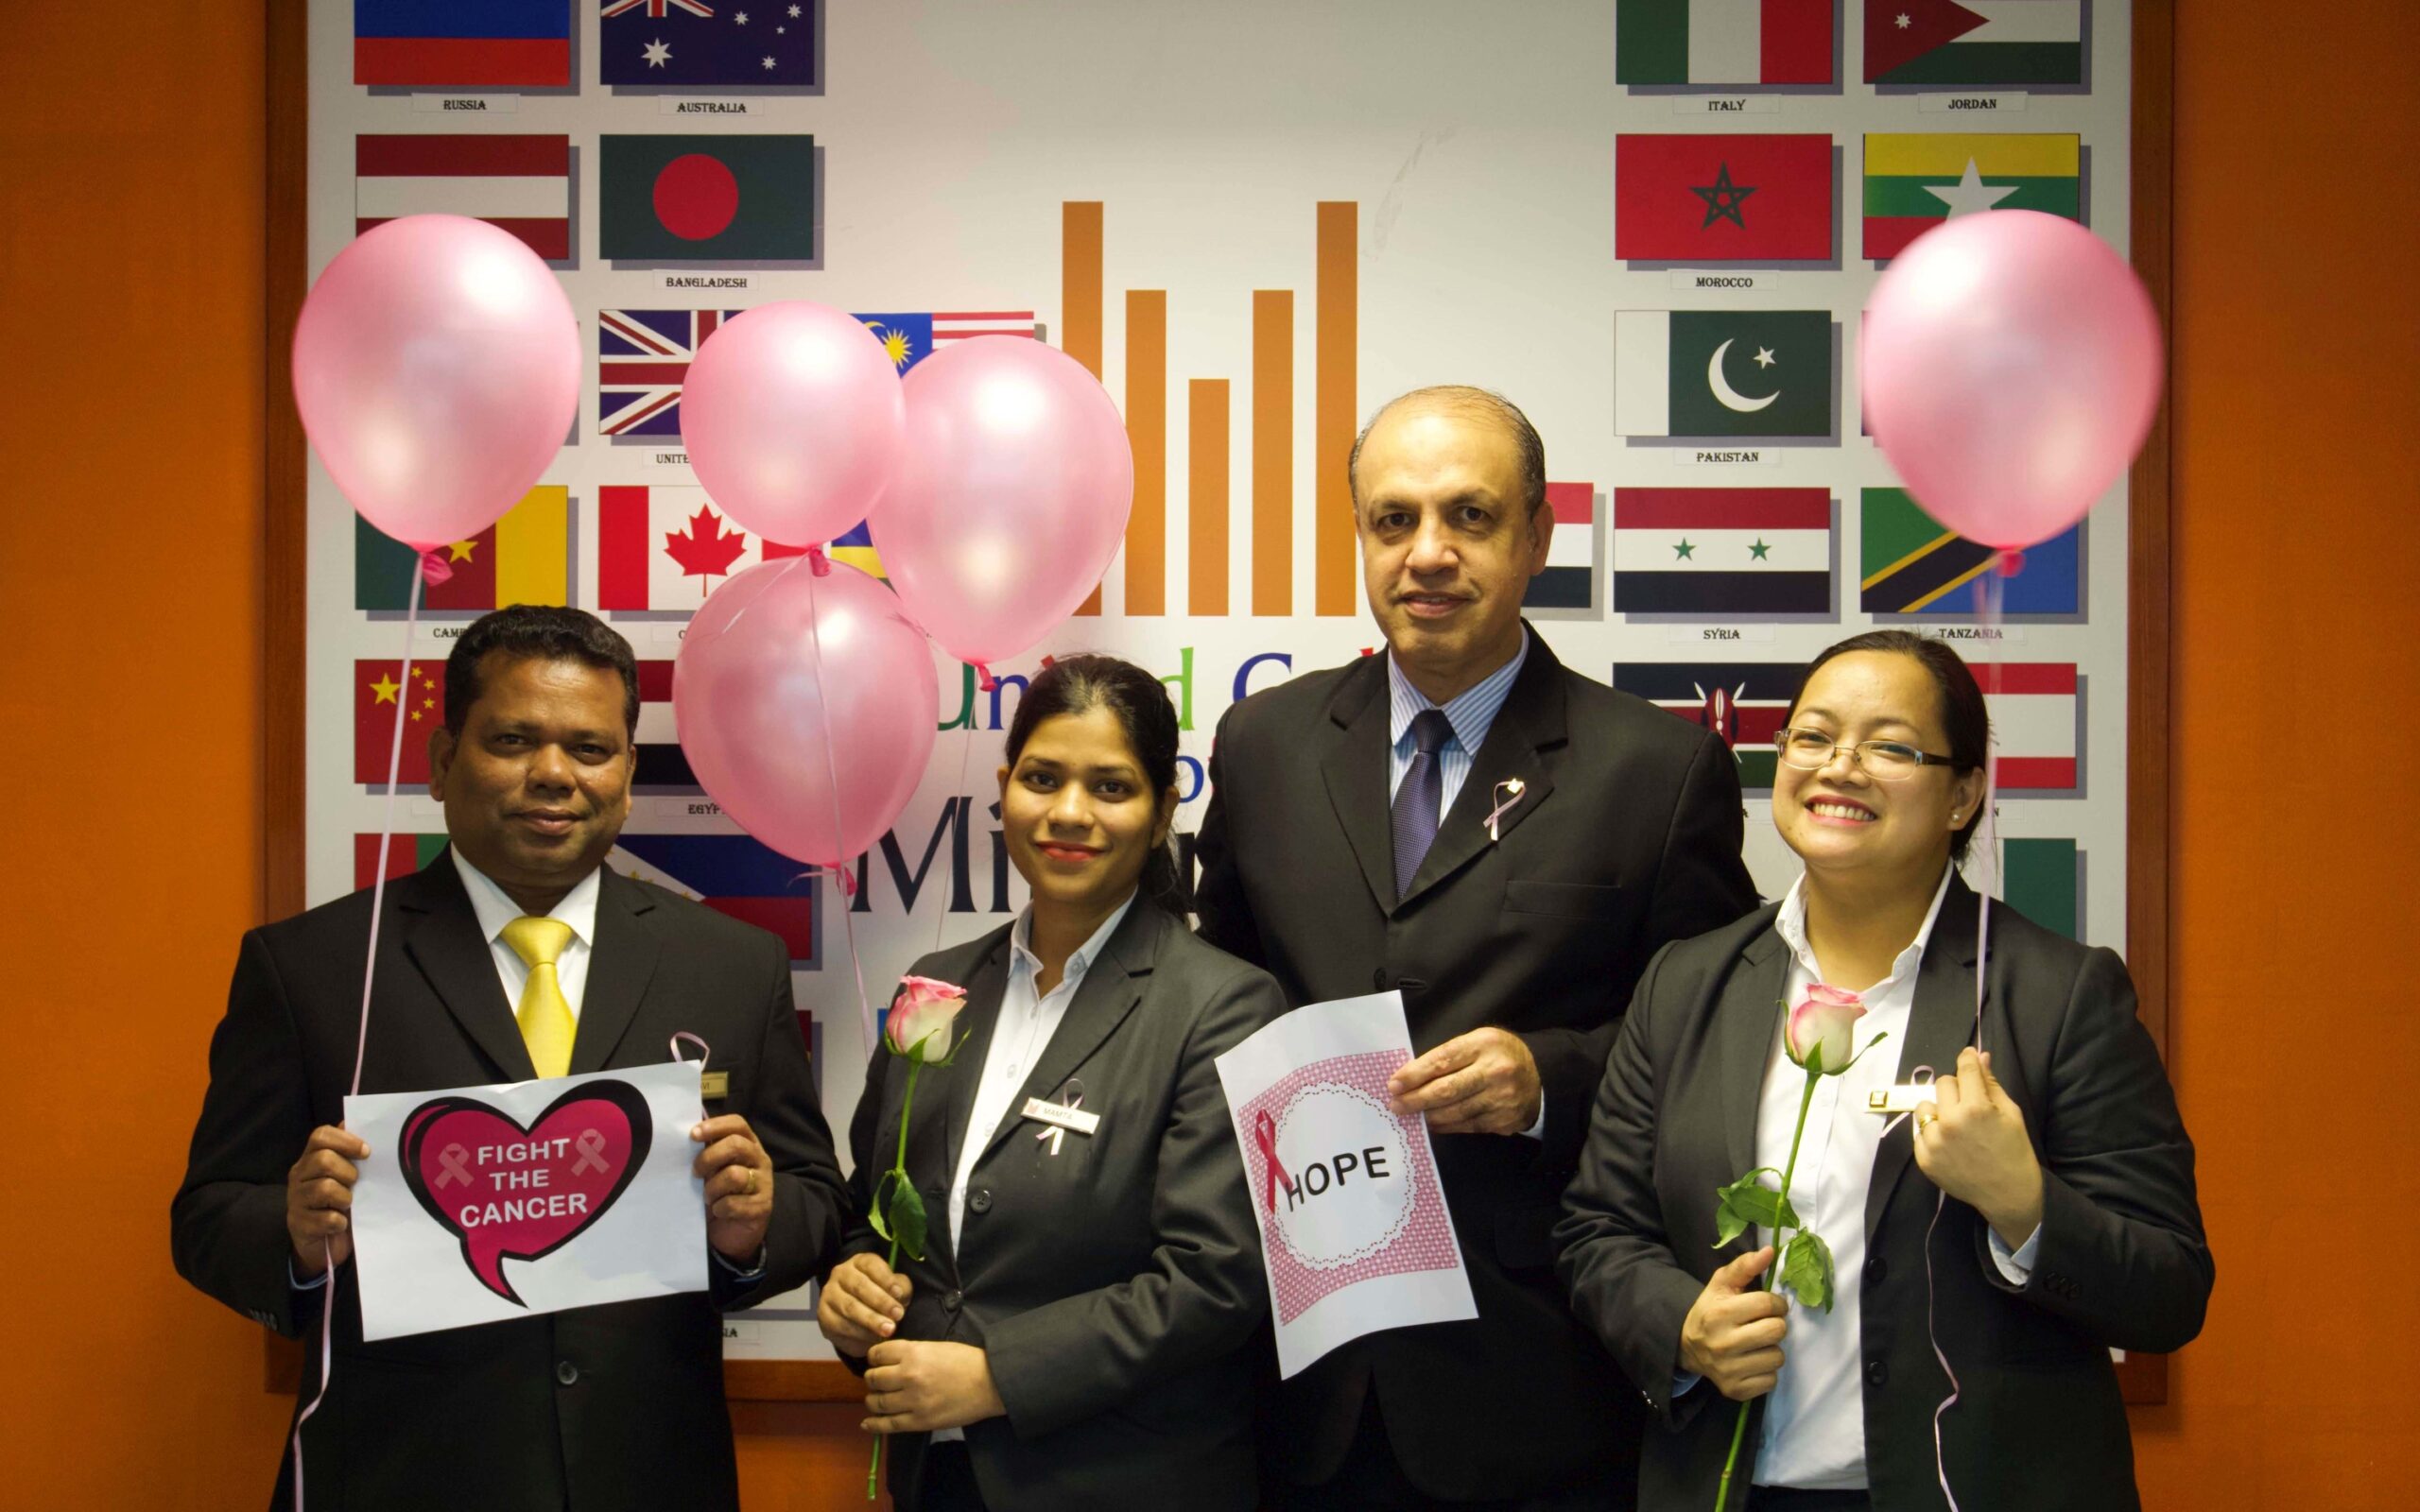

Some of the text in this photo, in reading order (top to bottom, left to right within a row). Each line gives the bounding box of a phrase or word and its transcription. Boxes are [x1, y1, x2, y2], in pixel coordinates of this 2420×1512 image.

[442, 99, 487, 111] RUSSIA
[676, 102, 748, 114] AUSTRALIA
[1707, 99, 1746, 112] ITALY
[1947, 98, 1997, 111] JORDAN
[666, 276, 748, 288] BANGLADESH
[1695, 276, 1754, 288] MOROCCO
[656, 454, 690, 464] UNITE
[1696, 452, 1759, 463] PAKISTAN
[1703, 627, 1741, 641] SYRIA
[1938, 627, 2003, 640] TANZANIA
[687, 802, 726, 816] EGYP
[477, 1138, 571, 1166] FIGHT
[488, 1169, 550, 1192] THE
[1284, 1145, 1392, 1212] HOPE
[459, 1193, 588, 1228] CANCER
